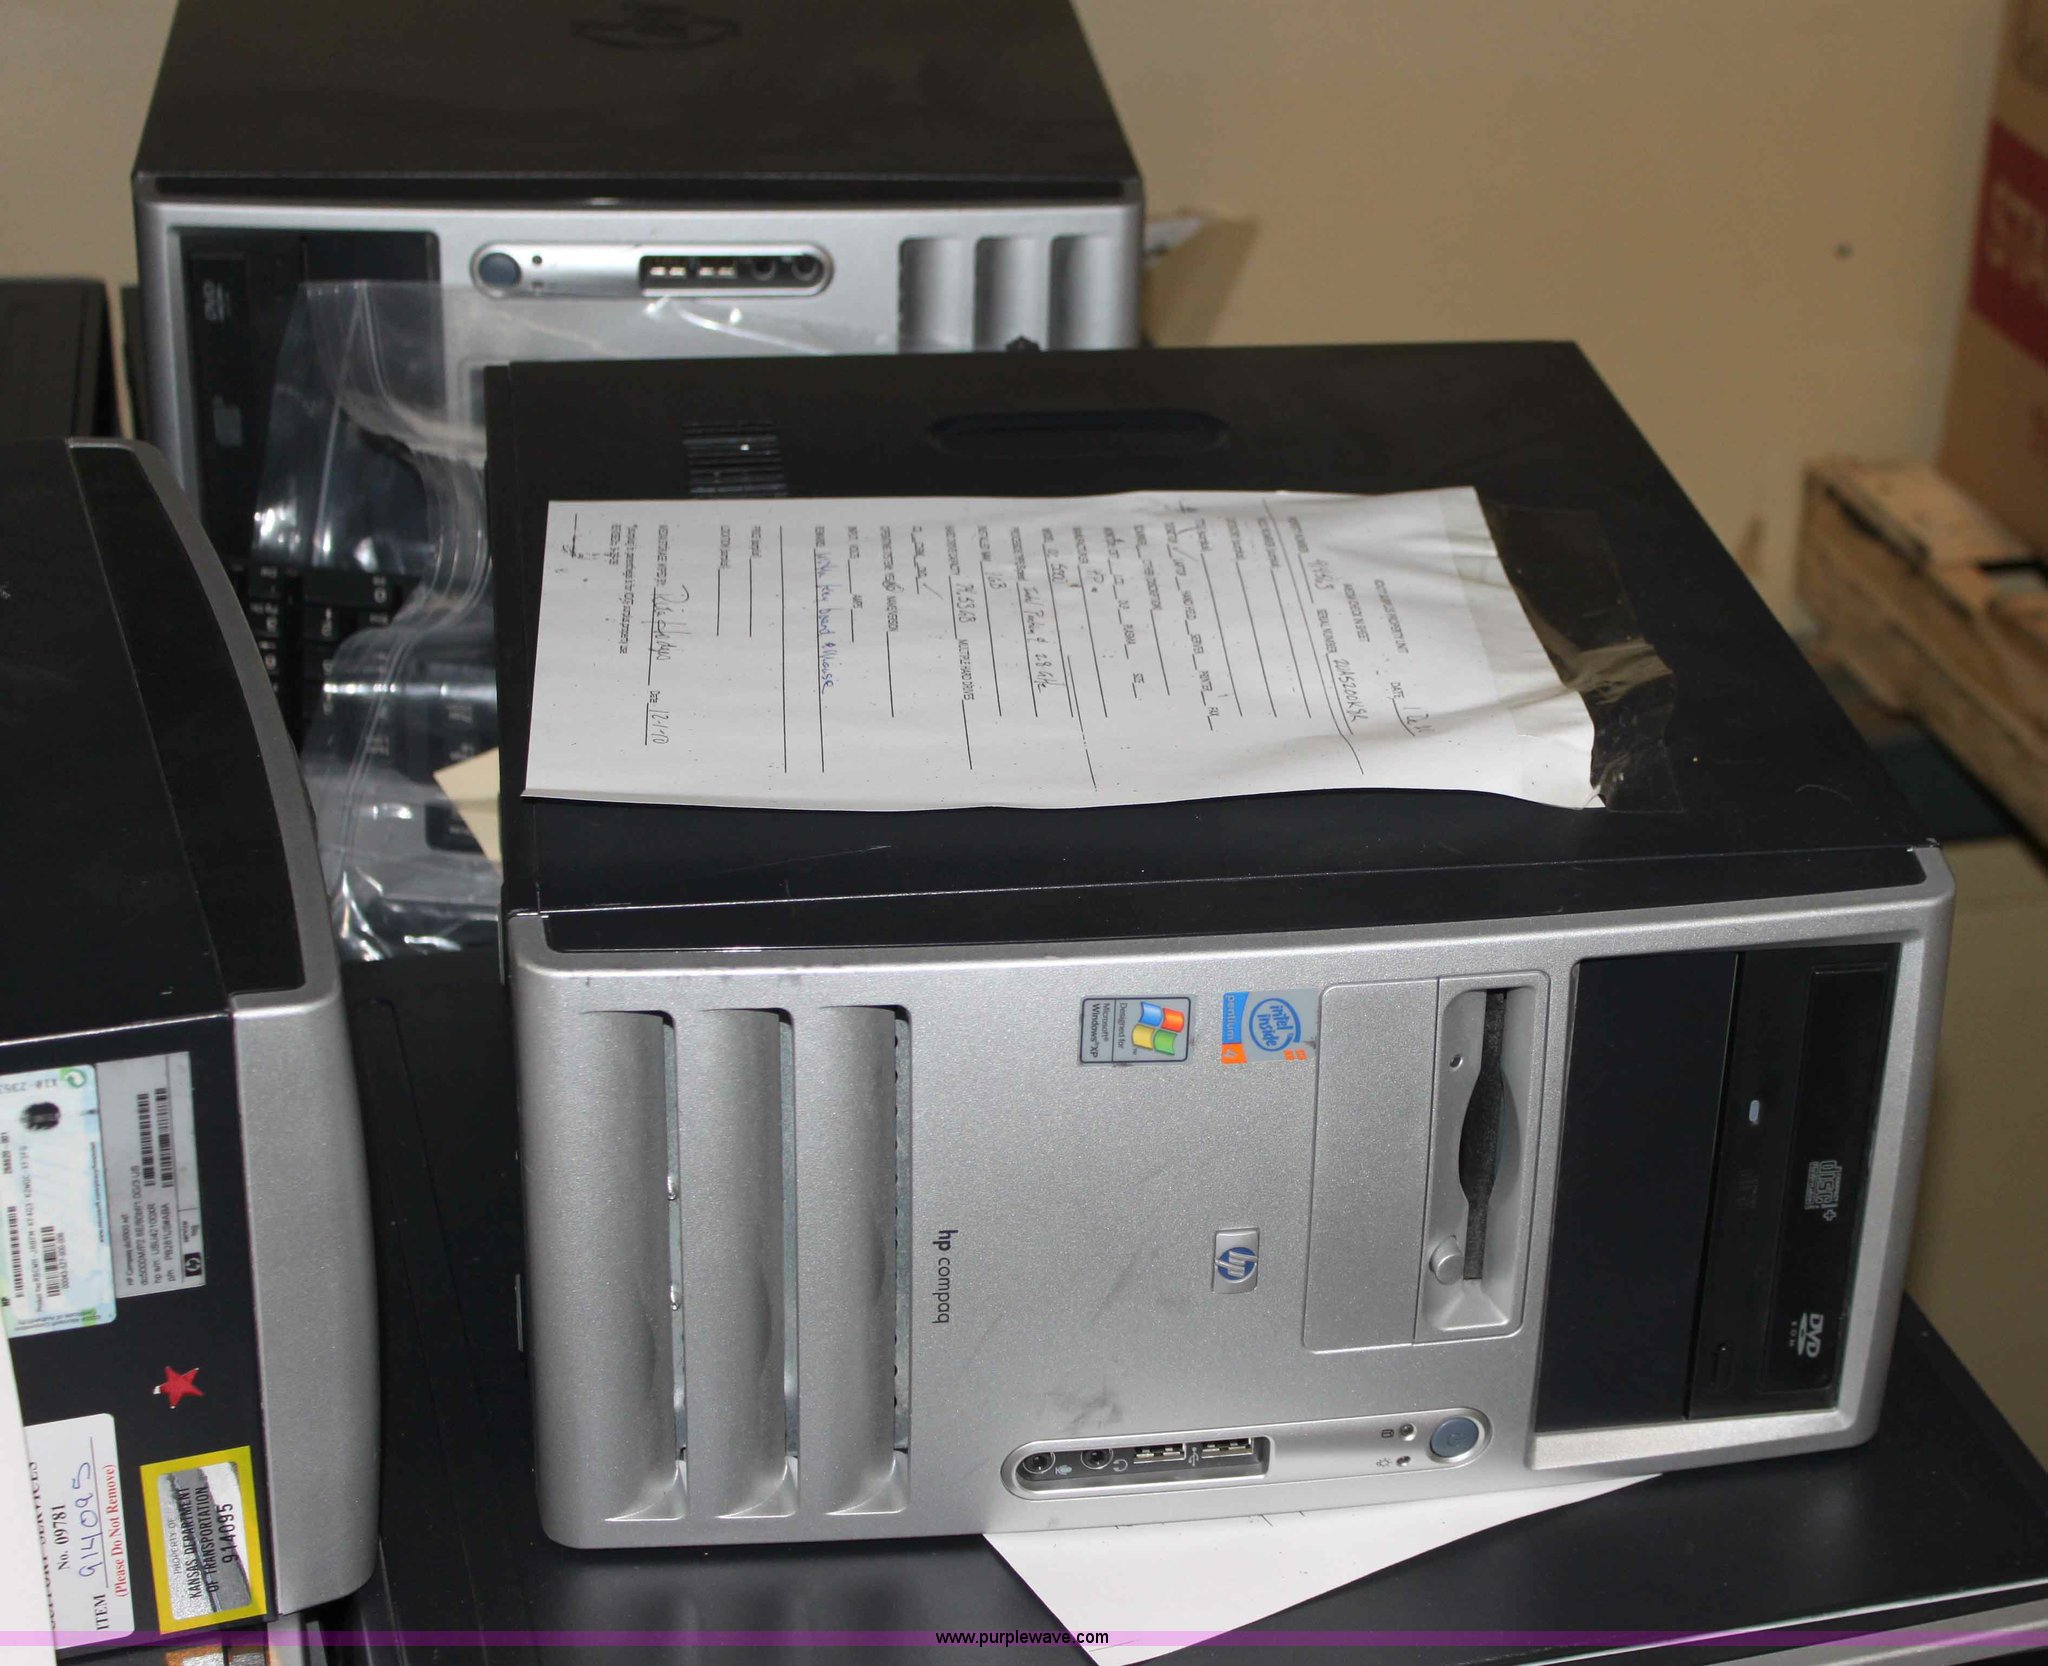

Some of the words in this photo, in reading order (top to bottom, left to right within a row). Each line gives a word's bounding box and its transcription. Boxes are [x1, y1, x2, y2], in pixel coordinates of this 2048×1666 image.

[1316, 608, 1331, 626] SERIAL
[1384, 613, 1404, 640] PROPERTY
[957, 639, 972, 665] MULTIPLE
[1321, 627, 1337, 654] NUMBER
[959, 665, 973, 680] HARD
[1190, 633, 1204, 654] SERVER
[1199, 670, 1214, 692] PRINTER
[961, 681, 976, 701] DRIVES
[1117, 1002, 1127, 1034] Designed
[1225, 994, 1236, 1041] pentium
[1257, 1013, 1279, 1047] inside
[1269, 1005, 1294, 1032] intel
[1117, 1036, 1125, 1049] for
[932, 1229, 959, 1251] hp
[932, 1258, 950, 1324] compaq
[1805, 1312, 1824, 1358] DVD
[103, 1464, 119, 1514] Remove)
[50, 1504, 69, 1545] 09781
[72, 1462, 103, 1578] 914095
[107, 1516, 120, 1538] Not
[168, 1518, 177, 1529] OF
[177, 1486, 198, 1555] DEPARTMENT
[195, 1486, 218, 1575] TRANSPORTATION
[216, 1503, 239, 1564] 914095
[56, 1550, 69, 1570] No.
[109, 1539, 123, 1557] Do
[168, 1531, 182, 1574] PROPERTY
[110, 1559, 128, 1598] (Please
[186, 1559, 202, 1599] KANSAS
[207, 1580, 220, 1593] OF
[92, 1593, 109, 1631] ITEM
